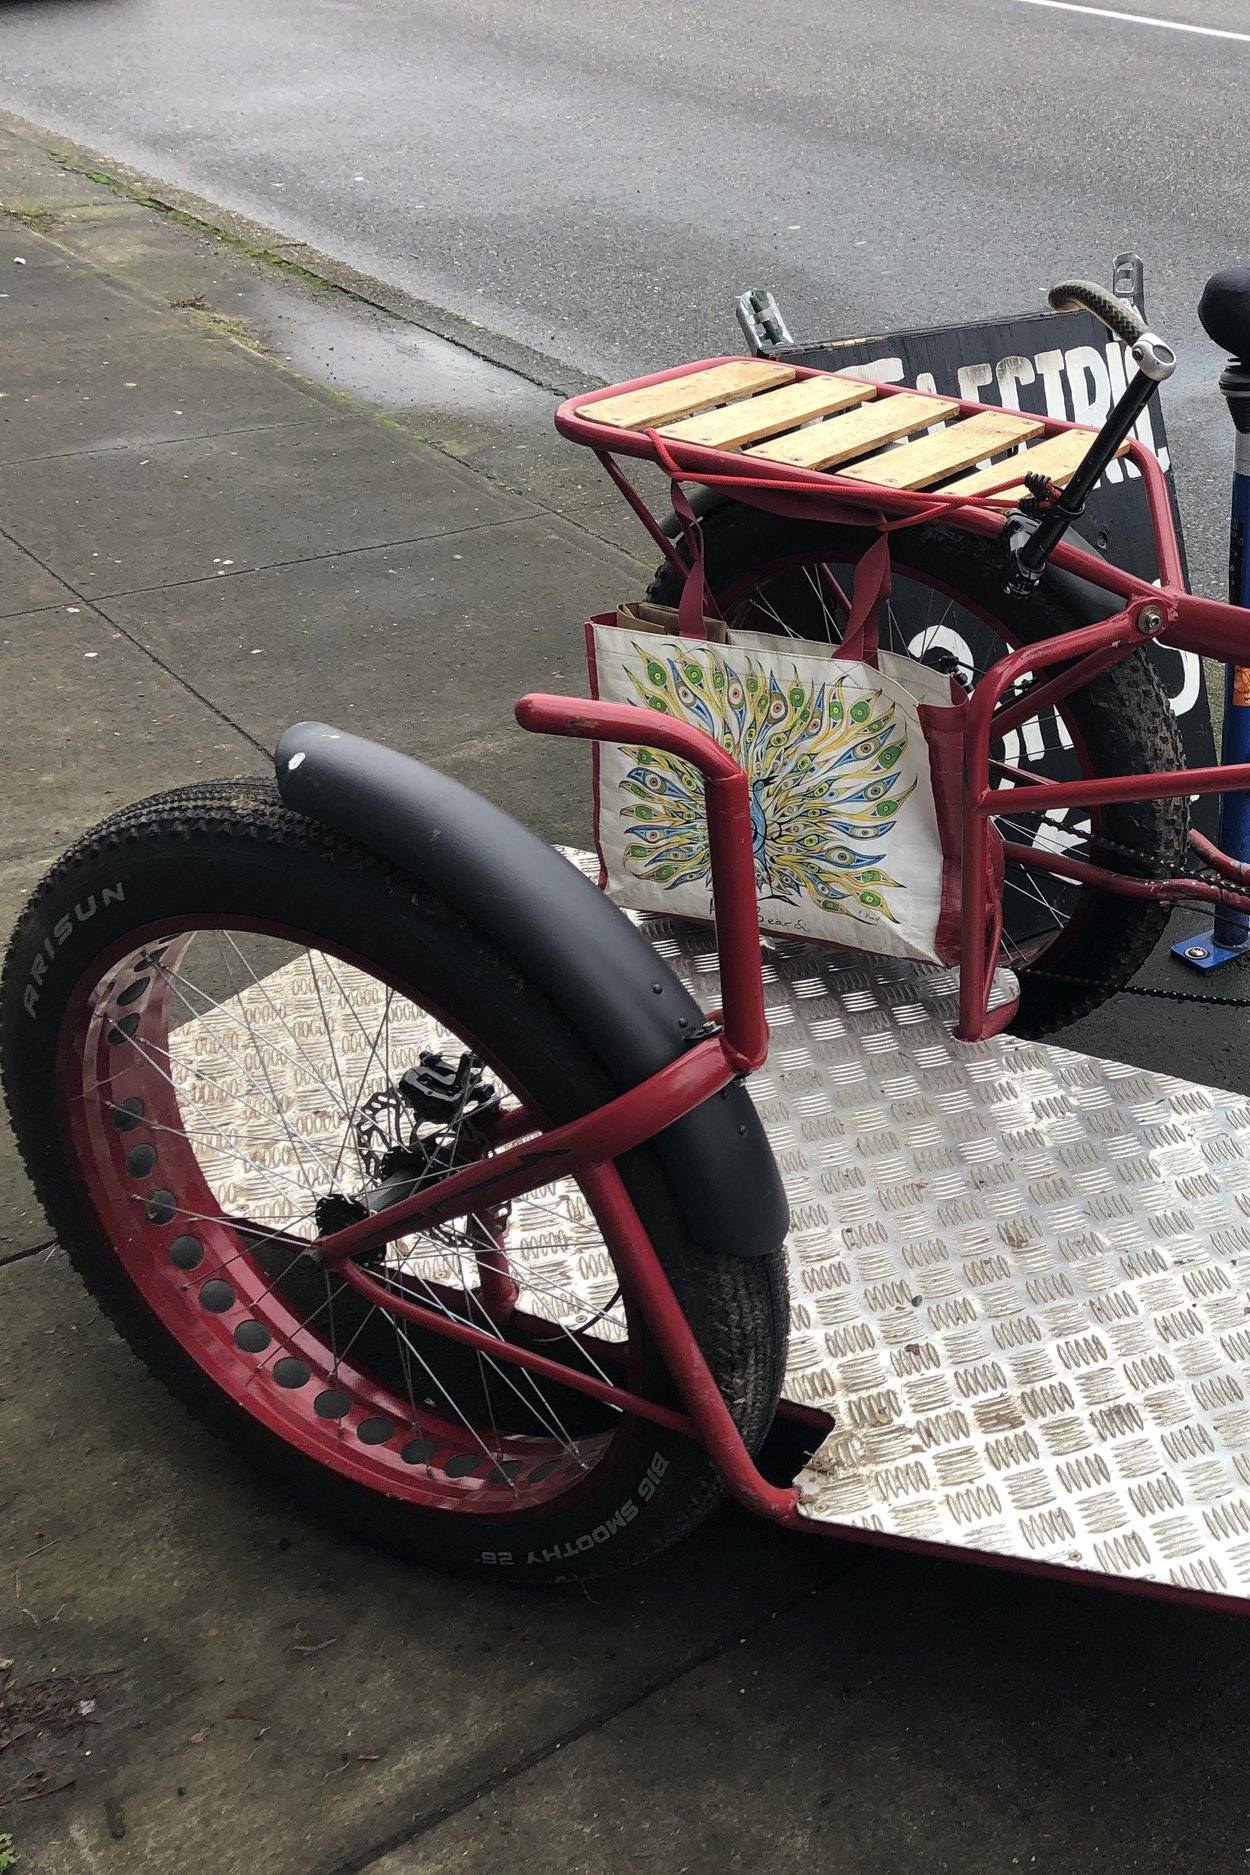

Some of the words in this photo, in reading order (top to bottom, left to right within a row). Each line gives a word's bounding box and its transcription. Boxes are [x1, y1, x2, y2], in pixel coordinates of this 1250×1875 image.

[24, 881, 127, 1020] ARISUN
[637, 1450, 671, 1503] BIG
[525, 1498, 640, 1565] SMOOTHY
